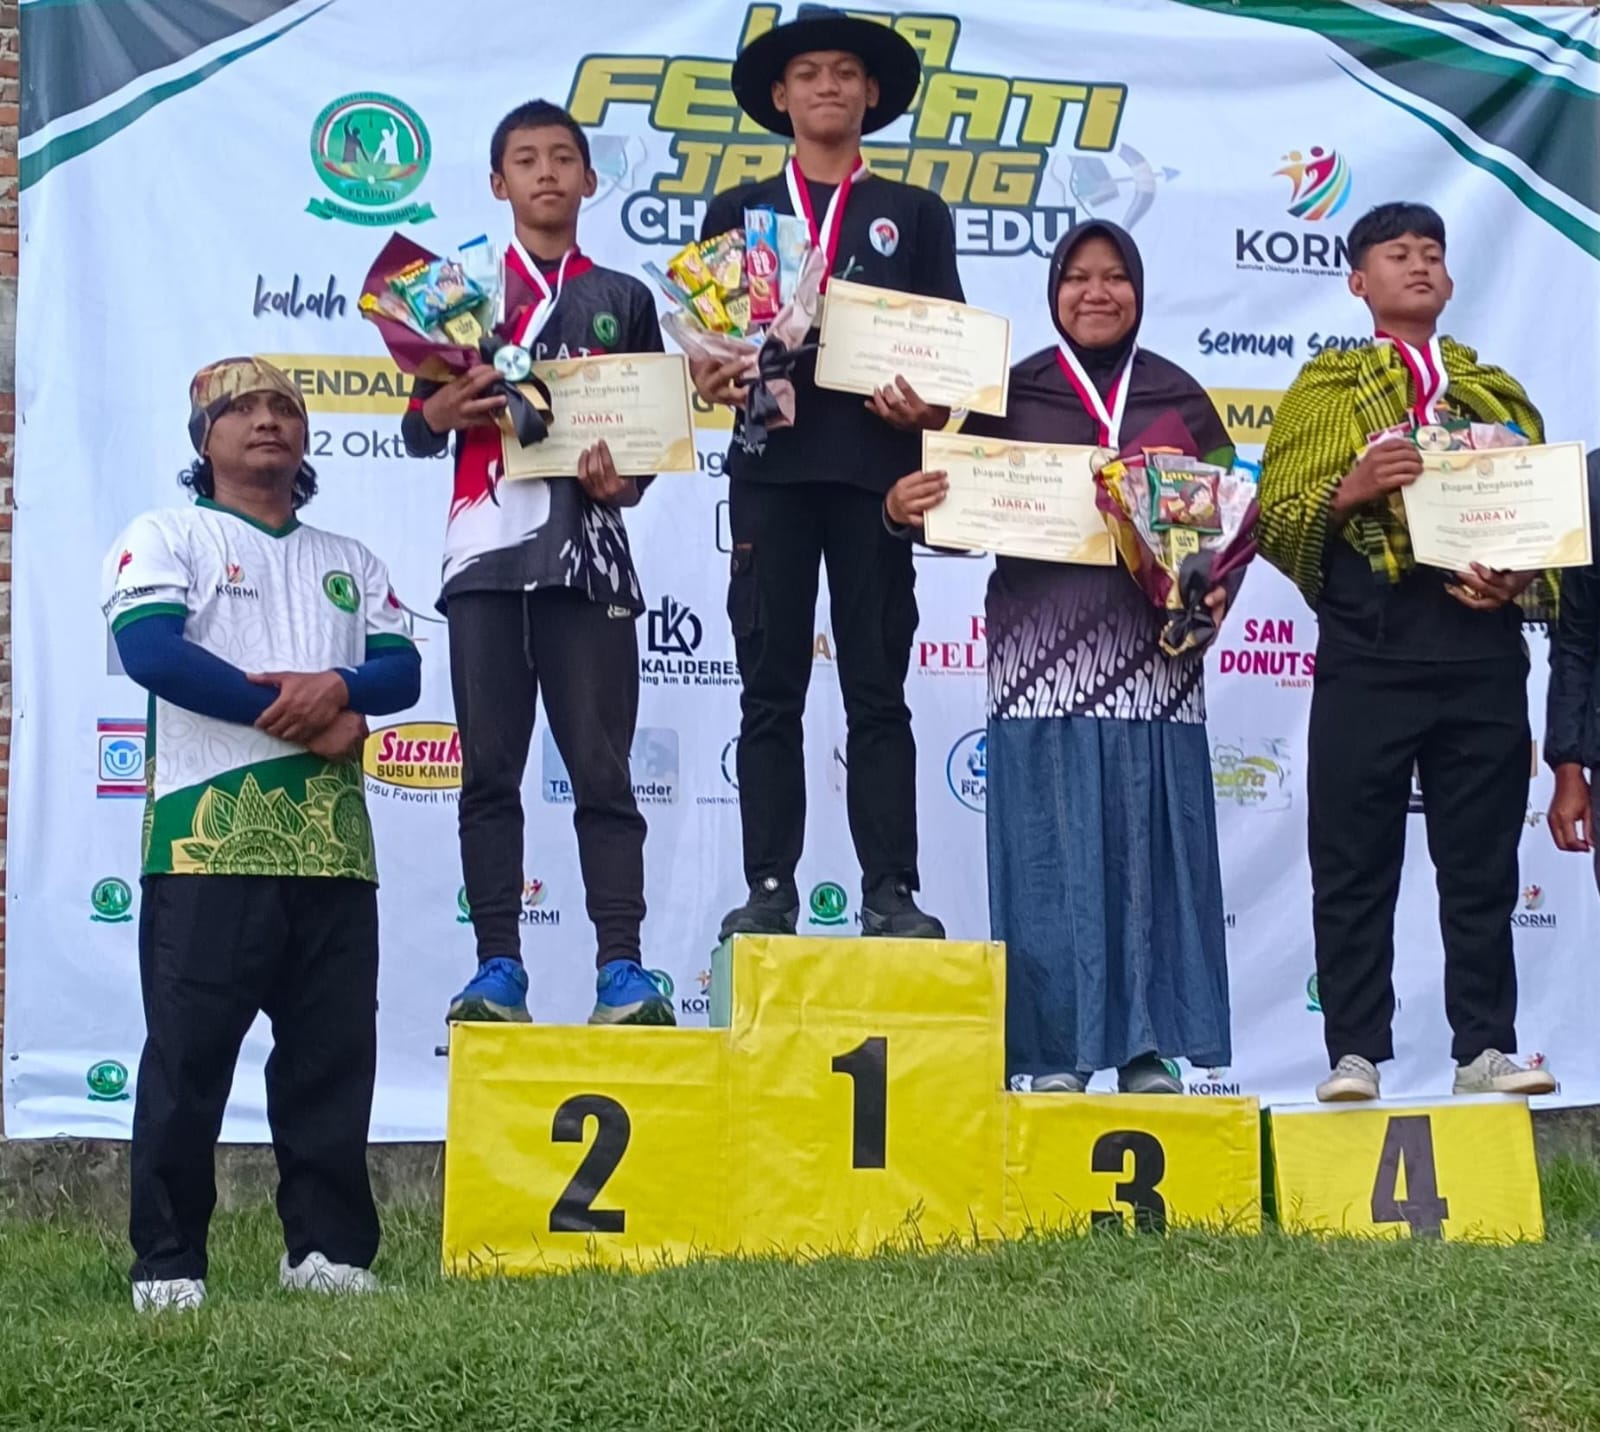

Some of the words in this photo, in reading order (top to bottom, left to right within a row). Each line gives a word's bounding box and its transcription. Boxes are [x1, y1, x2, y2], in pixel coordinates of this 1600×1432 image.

[567, 54, 1127, 152] FEATI
[657, 141, 1043, 206] JAENG
[953, 206, 1071, 254] EDU
[1236, 228, 1350, 268] KOR
[892, 343, 932, 358] JUARA
[282, 368, 413, 398] ENDAL
[570, 412, 613, 425] JUARA
[614, 413, 625, 425] II
[1226, 403, 1276, 429] MA
[991, 497, 1032, 511] JUARA
[1034, 501, 1046, 512] III
[1458, 510, 1501, 524] JUARA
[1504, 508, 1518, 521] IV
[214, 583, 259, 601] KORMI
[1244, 618, 1294, 644] SAN
[918, 641, 986, 668] PEL
[1219, 649, 1316, 677] DONUTS
[694, 675, 740, 685] Kalidere
[377, 730, 461, 763] Susuk
[377, 764, 415, 778] SUSU
[419, 765, 460, 779] KAMB
[365, 781, 390, 798] usu
[392, 787, 438, 804] Favorit
[697, 796, 739, 805] CONSTRUCT
[519, 909, 560, 925] ORMI
[1188, 1082, 1241, 1096] KORMI
[831, 1036, 888, 1170] 1
[548, 1093, 631, 1234] 2
[1090, 1129, 1167, 1236] 3
[1370, 1114, 1450, 1240] 4
